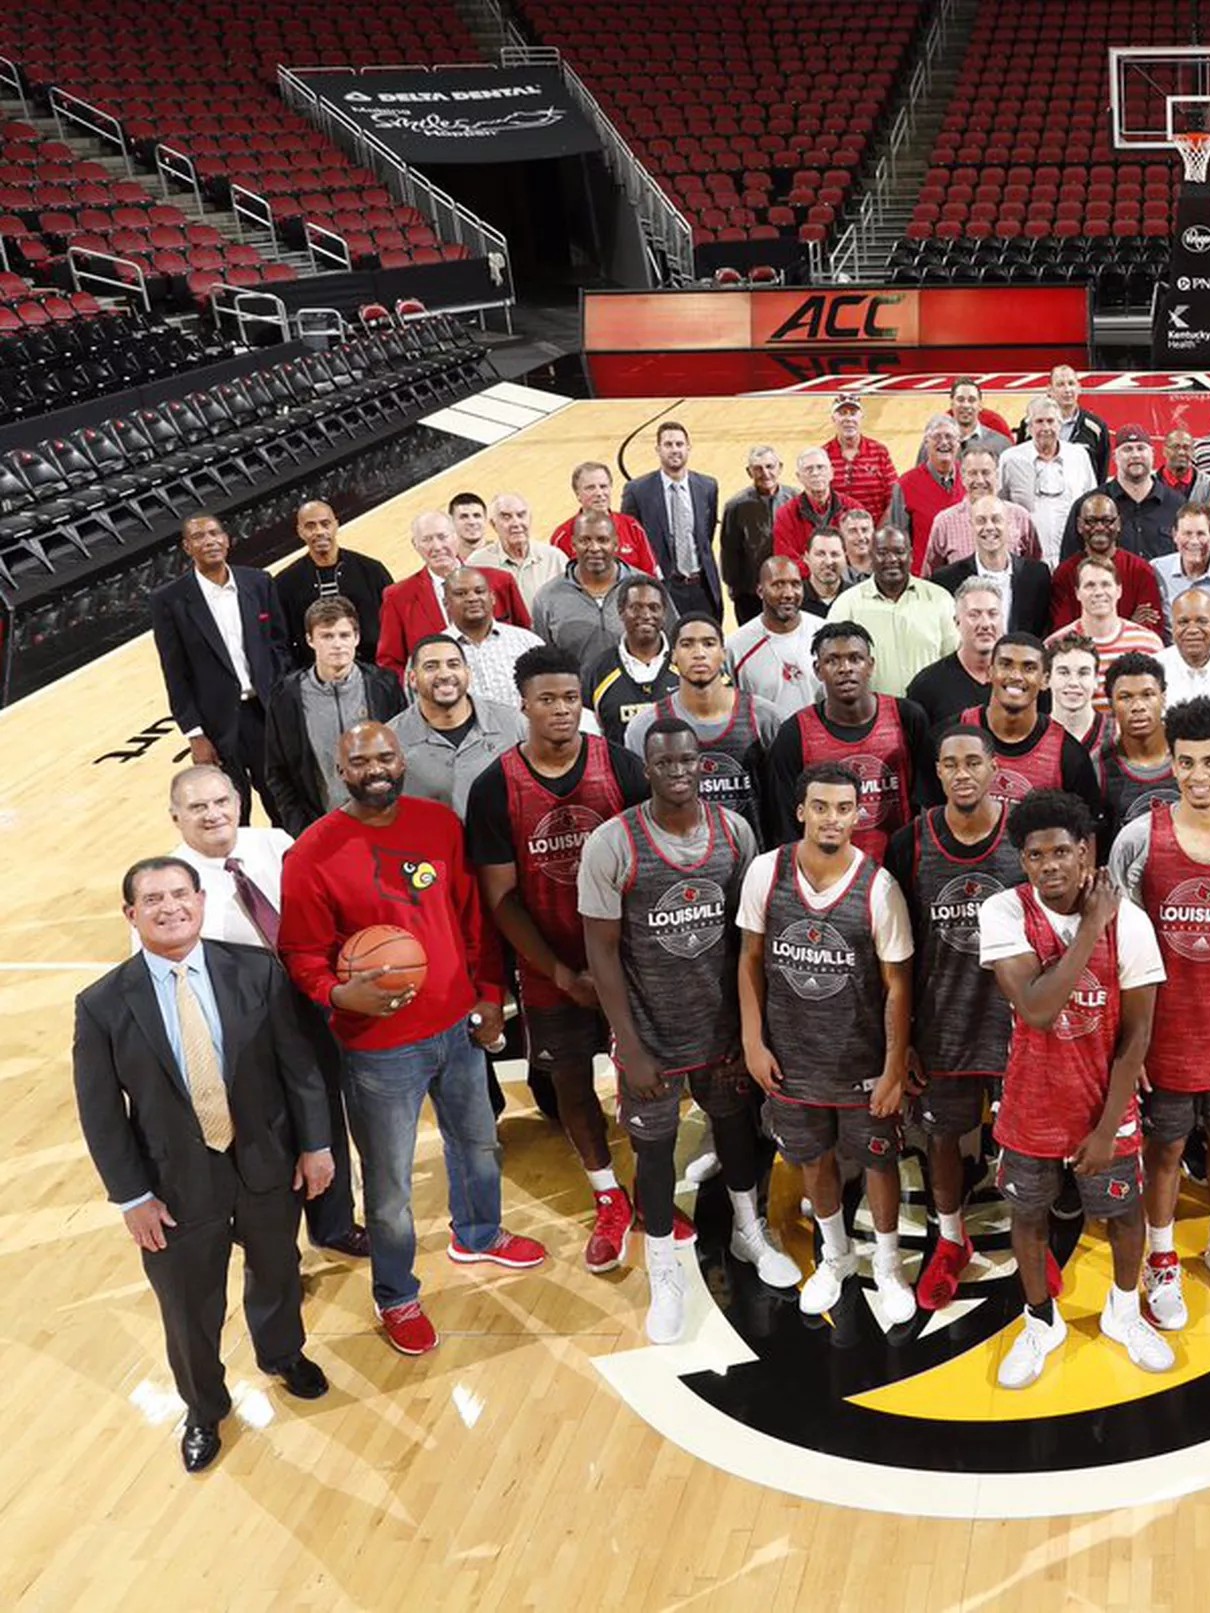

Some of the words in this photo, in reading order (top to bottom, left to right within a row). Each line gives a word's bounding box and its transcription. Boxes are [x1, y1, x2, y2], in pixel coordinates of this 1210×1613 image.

[378, 92, 449, 102] DELTA
[451, 86, 542, 100] DENTAL
[767, 294, 904, 338] ACC
[699, 775, 752, 793] ISVILLE
[861, 777, 899, 794] VILLE
[648, 902, 725, 927] LOUISVILL
[773, 941, 856, 967] LOUISVILLE
